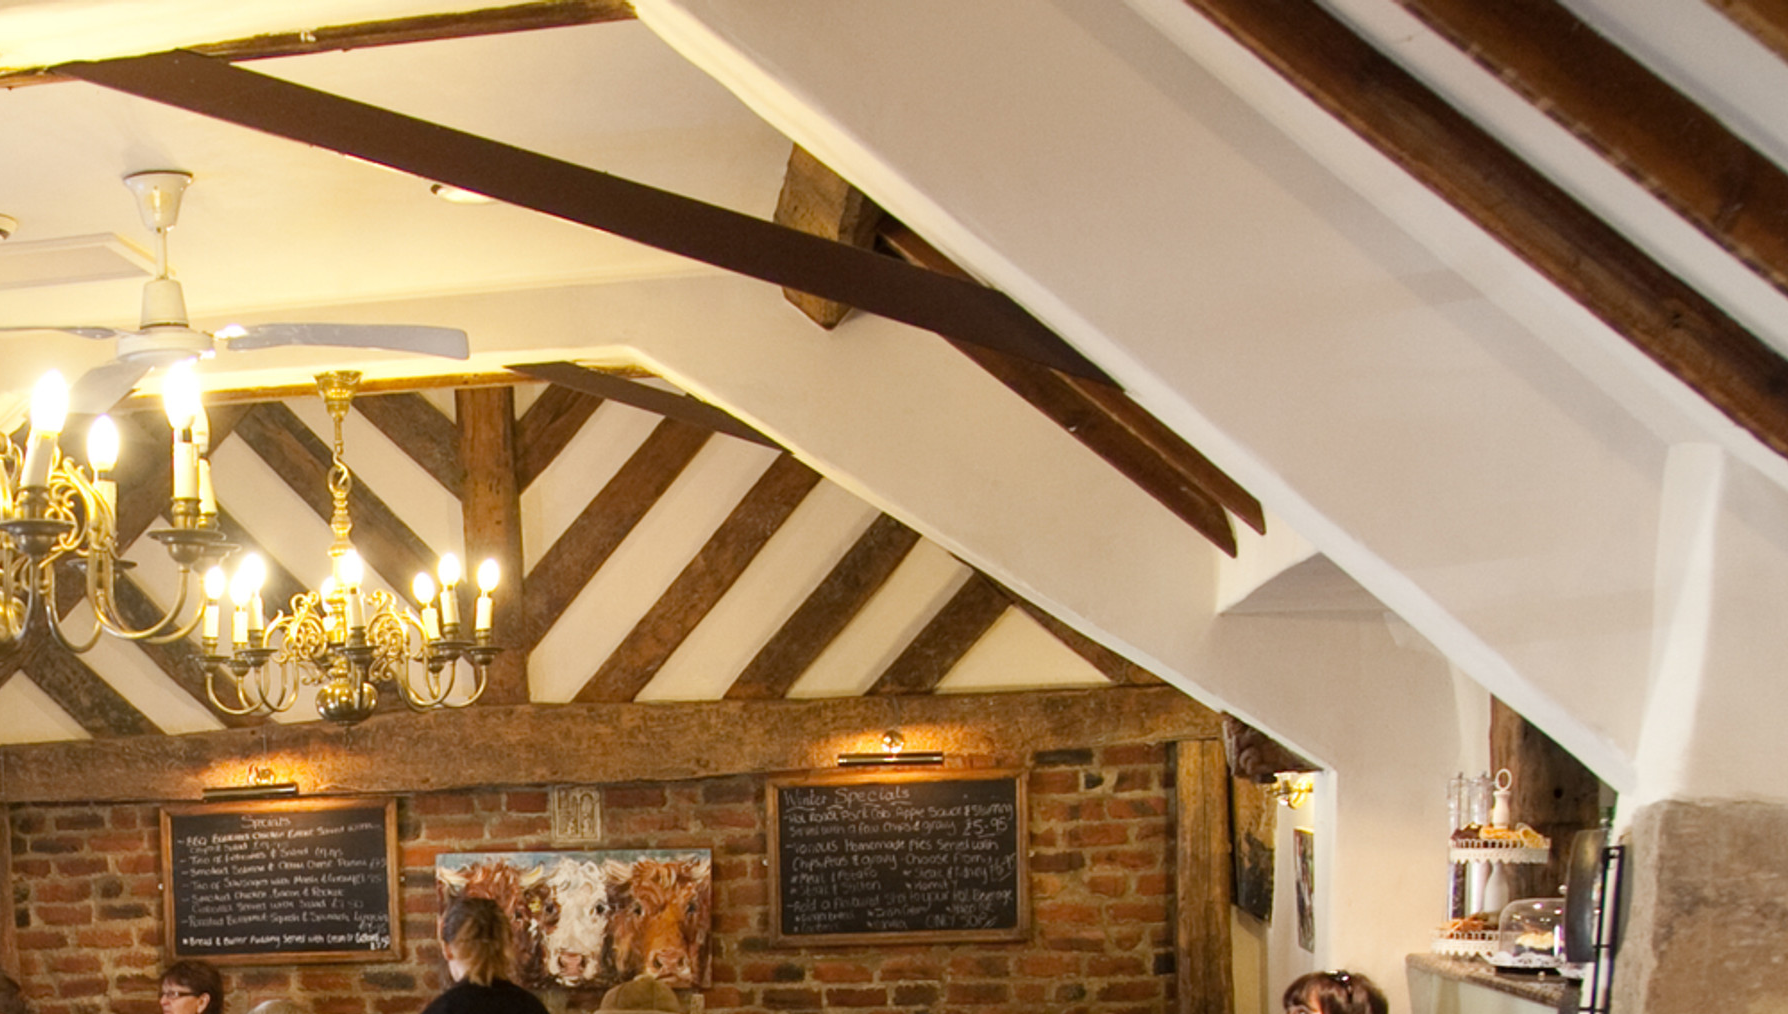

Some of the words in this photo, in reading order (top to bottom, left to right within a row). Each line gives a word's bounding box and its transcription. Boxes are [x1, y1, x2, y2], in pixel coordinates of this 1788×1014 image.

[783, 788, 827, 807] Winter
[834, 785, 911, 809] Specials
[847, 824, 856, 834] a
